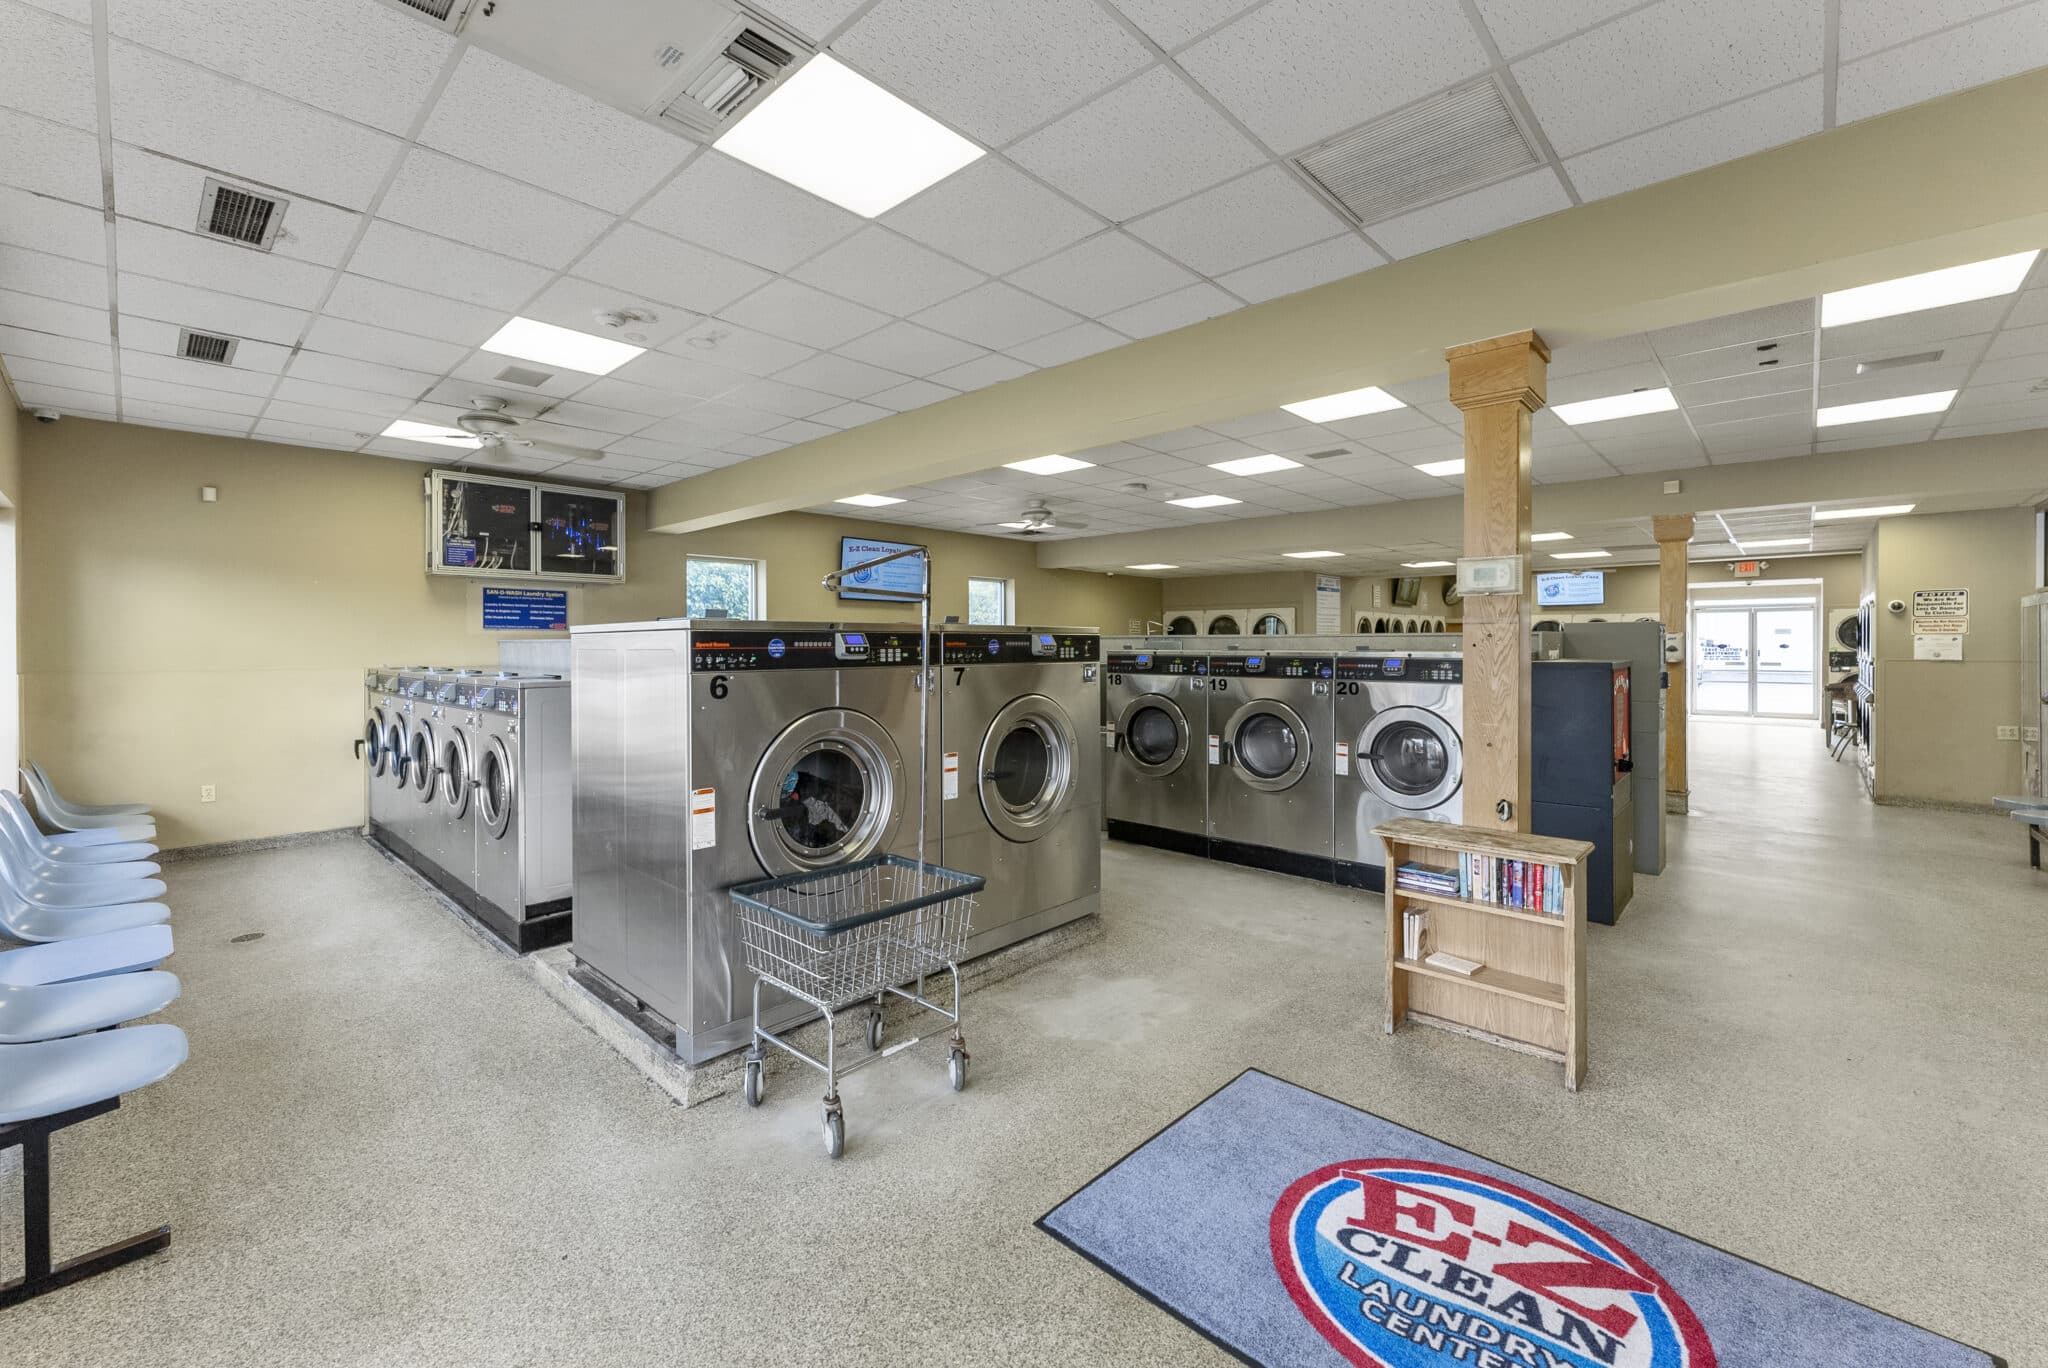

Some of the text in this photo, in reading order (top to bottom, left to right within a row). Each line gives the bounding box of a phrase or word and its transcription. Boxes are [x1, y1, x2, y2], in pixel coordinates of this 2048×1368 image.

[710, 675, 729, 700] 6
[953, 667, 965, 686] 7
[1108, 674, 1122, 685] 18
[1209, 678, 1228, 692] 19
[1336, 681, 1359, 696] 20
[1341, 1170, 1658, 1338] E-Z
[1336, 1227, 1626, 1366] CLEAN
[1337, 1260, 1580, 1368] LAUNDRY
[1359, 1296, 1527, 1368] CENTE
